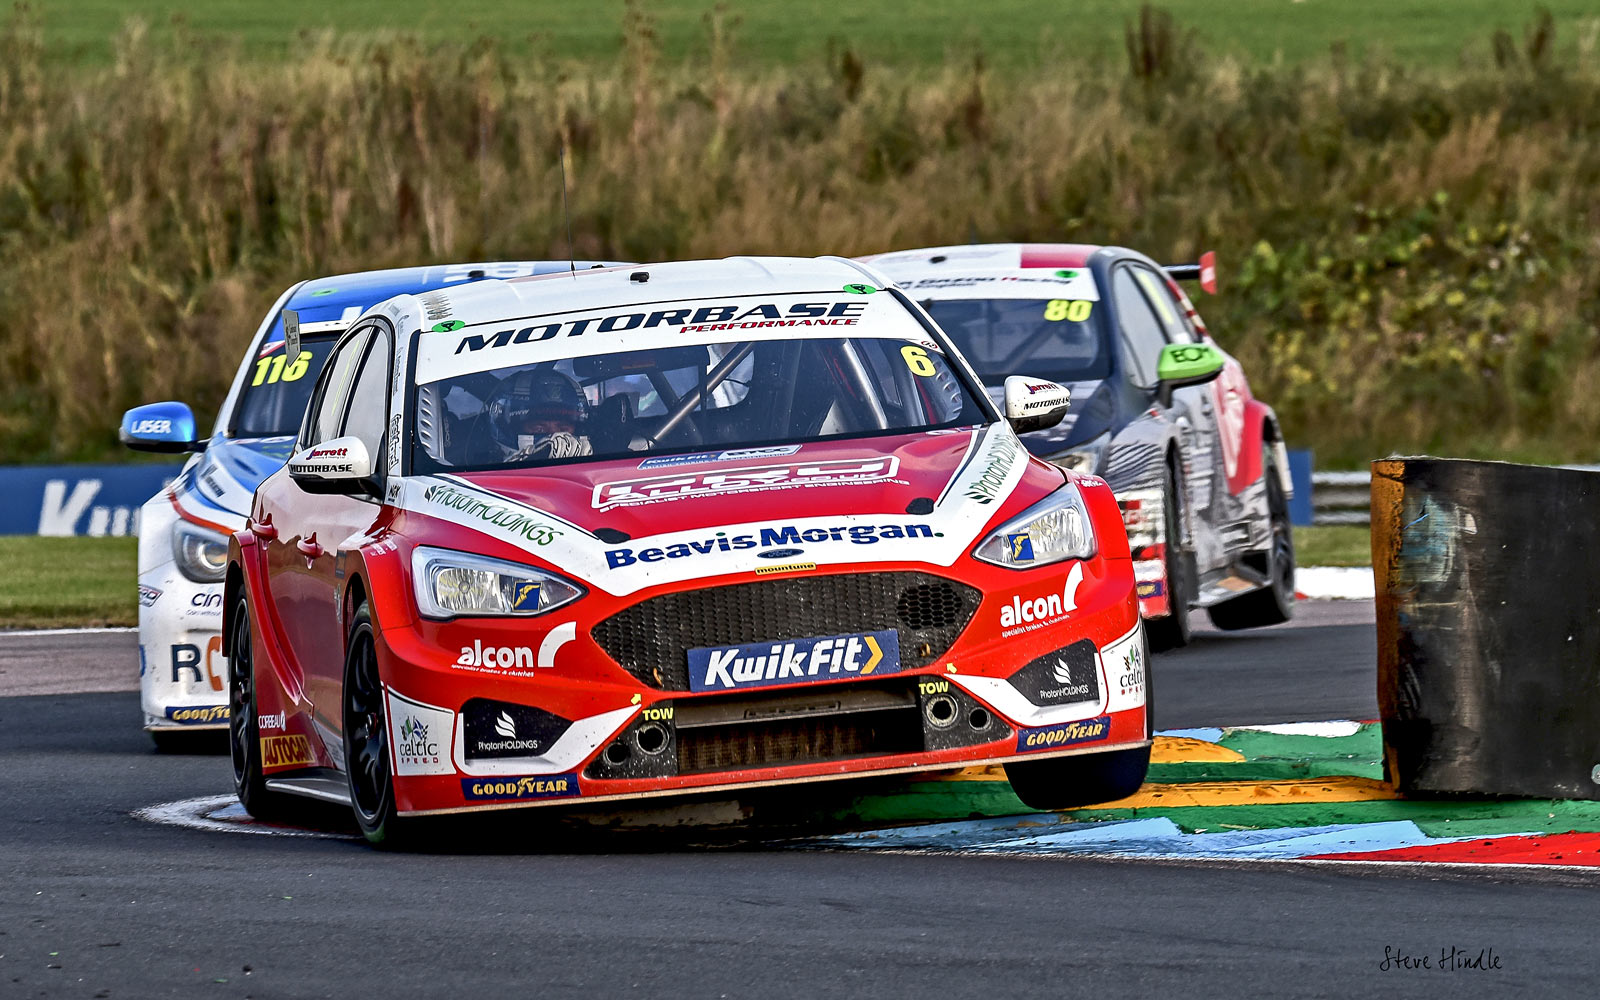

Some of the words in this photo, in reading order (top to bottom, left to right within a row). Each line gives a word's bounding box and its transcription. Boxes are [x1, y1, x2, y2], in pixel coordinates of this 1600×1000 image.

[1044, 300, 1093, 322] 80
[454, 302, 869, 355] MOTORBASE
[679, 318, 859, 334] PERFORMANCE
[251, 351, 313, 387] 116
[900, 345, 937, 378] 6
[131, 419, 172, 434] LASER
[288, 464, 353, 473] MOTORBASE
[756, 564, 814, 574] mountune
[1000, 593, 1063, 628] alcon
[457, 639, 534, 669] alcon
[919, 682, 949, 695] TOW
[642, 708, 674, 721] TOW
[263, 736, 313, 766] AUTOCAR
